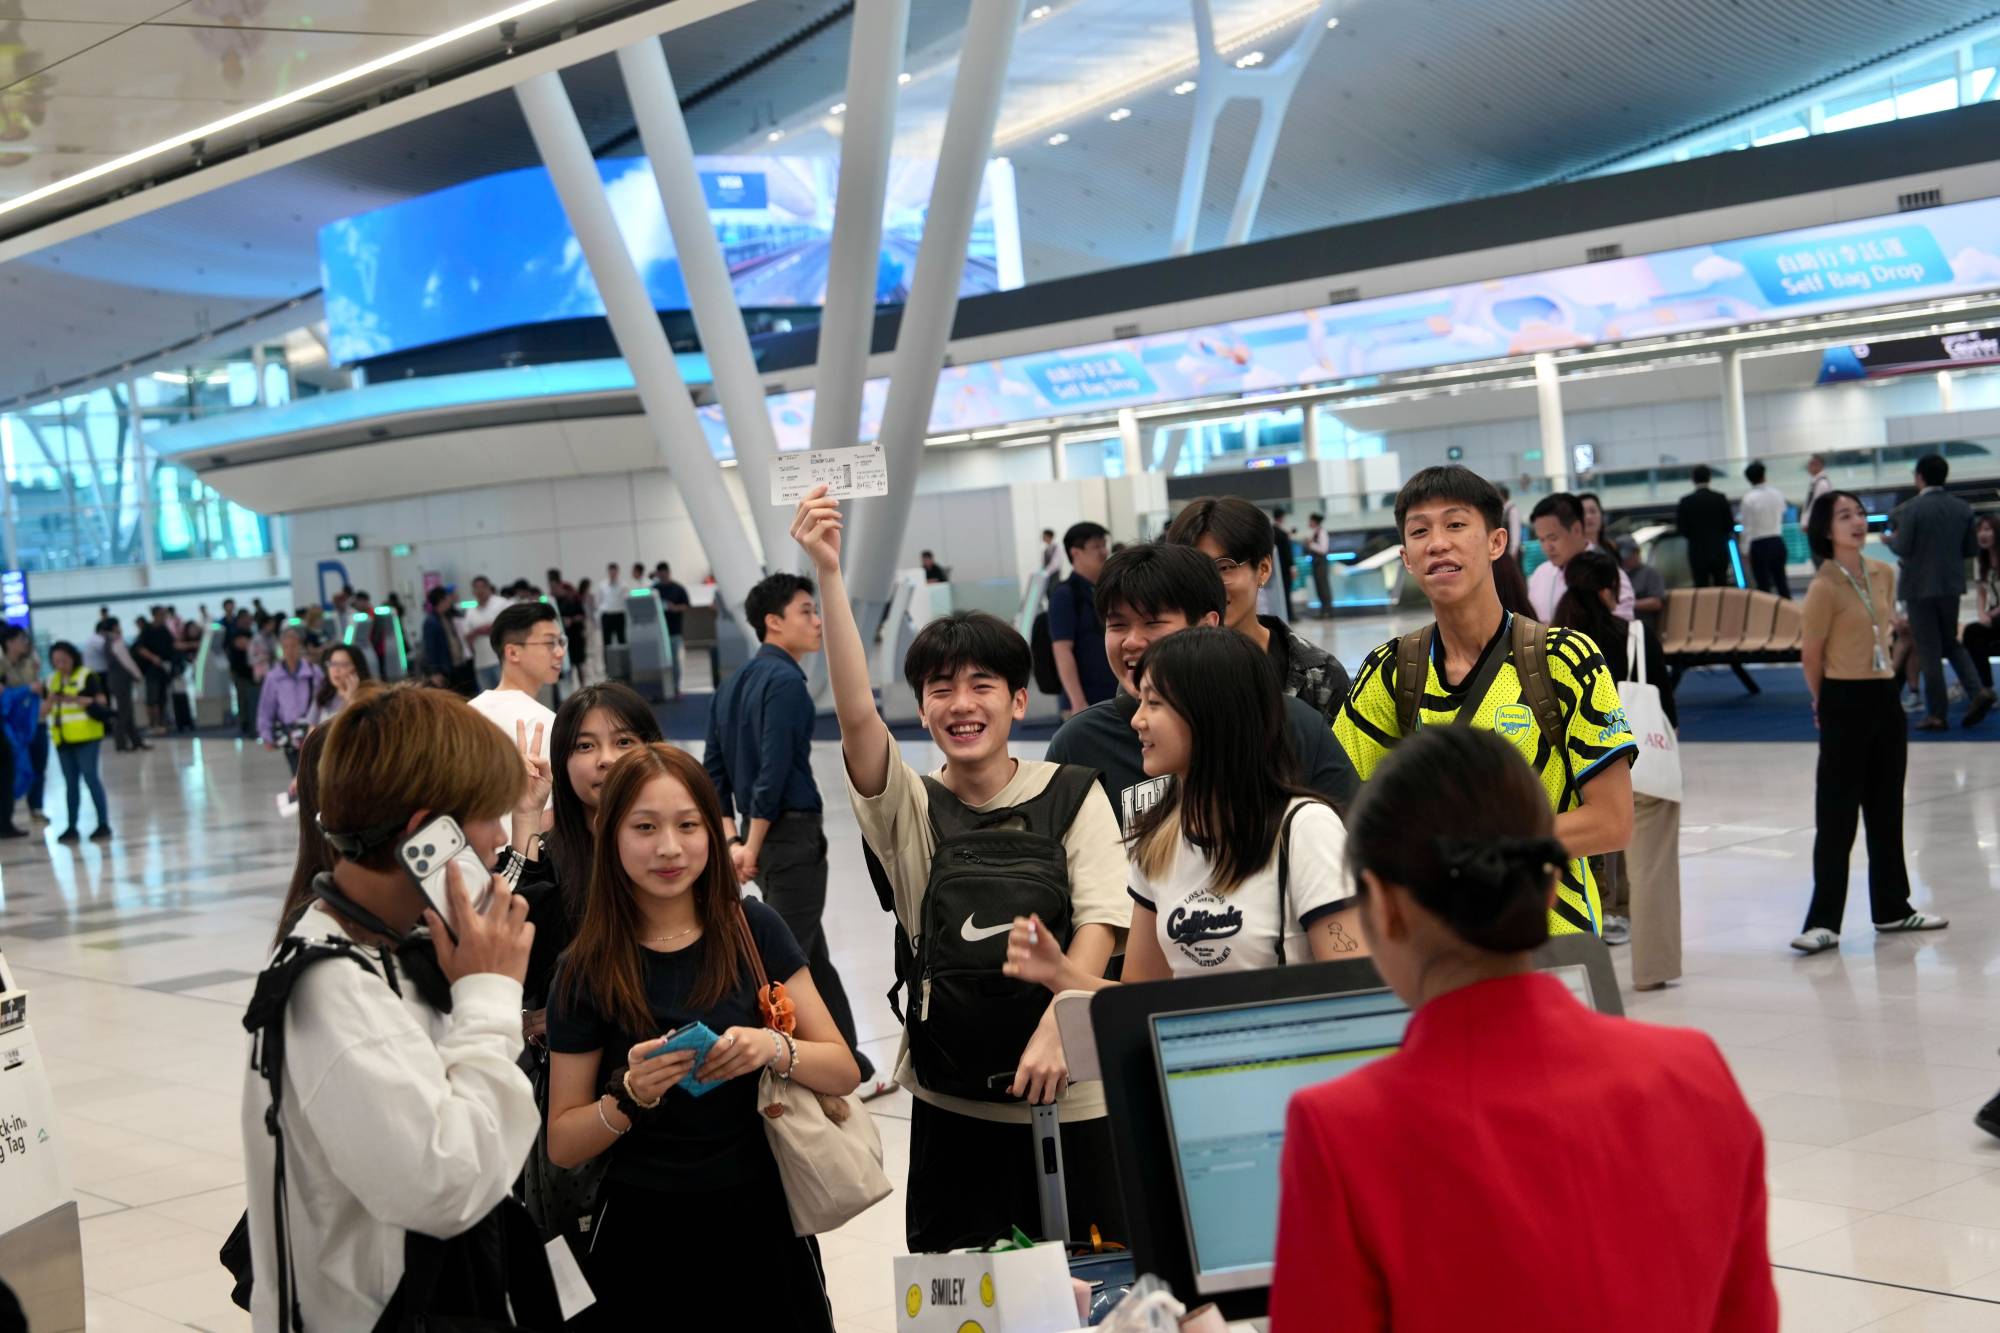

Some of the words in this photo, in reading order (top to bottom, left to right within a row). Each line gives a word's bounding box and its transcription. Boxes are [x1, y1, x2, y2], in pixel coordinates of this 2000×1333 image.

[1780, 273, 1824, 296] Self
[1827, 268, 1872, 289] Bag
[1872, 262, 1925, 283] Drop
[1500, 711, 1526, 720] Arsenal
[6, 1136, 26, 1154] Tag
[931, 1278, 965, 1305] SMILEY
